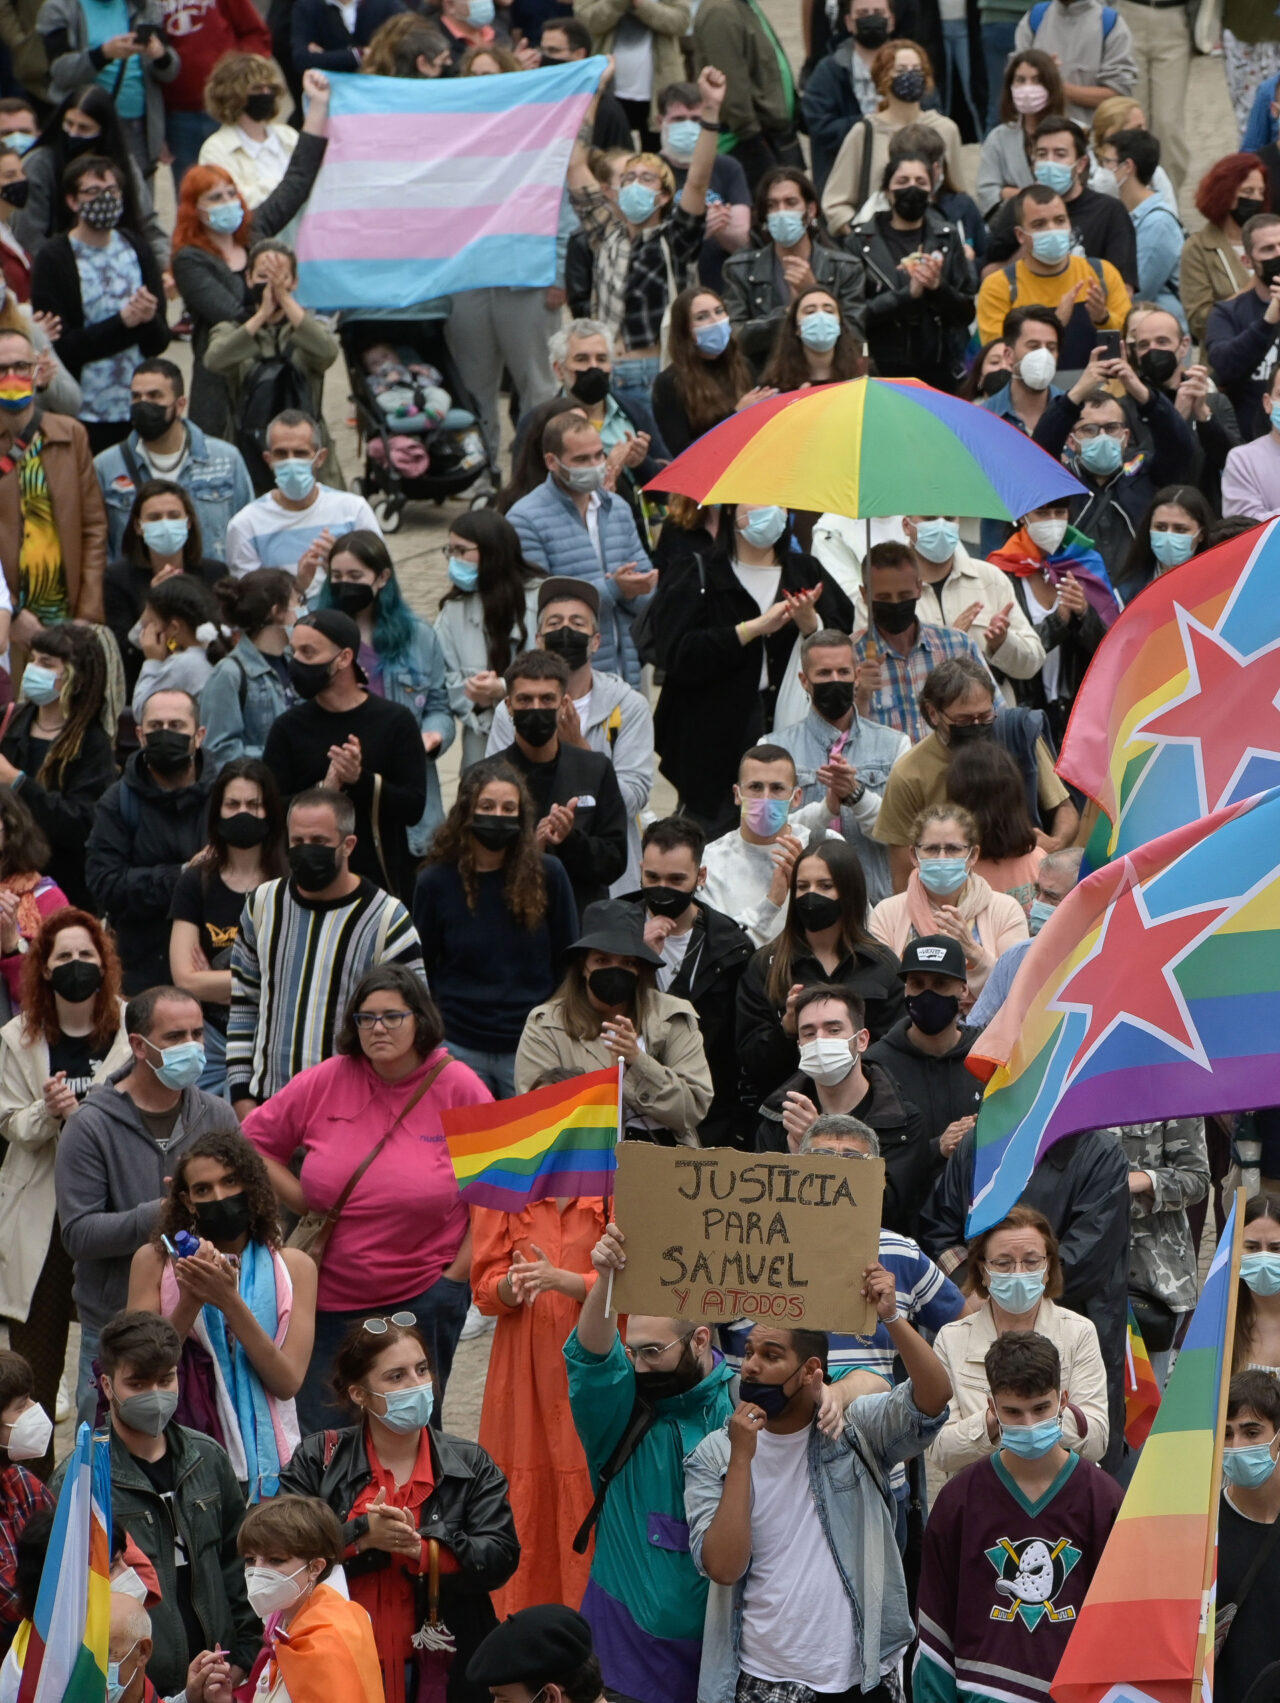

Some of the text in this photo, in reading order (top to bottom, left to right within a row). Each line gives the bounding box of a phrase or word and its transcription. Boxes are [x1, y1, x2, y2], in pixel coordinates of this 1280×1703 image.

[675, 1160, 857, 1207] JUSTICIA
[703, 1208, 790, 1245] PARA
[660, 1246, 808, 1288] SAMUEL
[673, 1287, 690, 1313] Y
